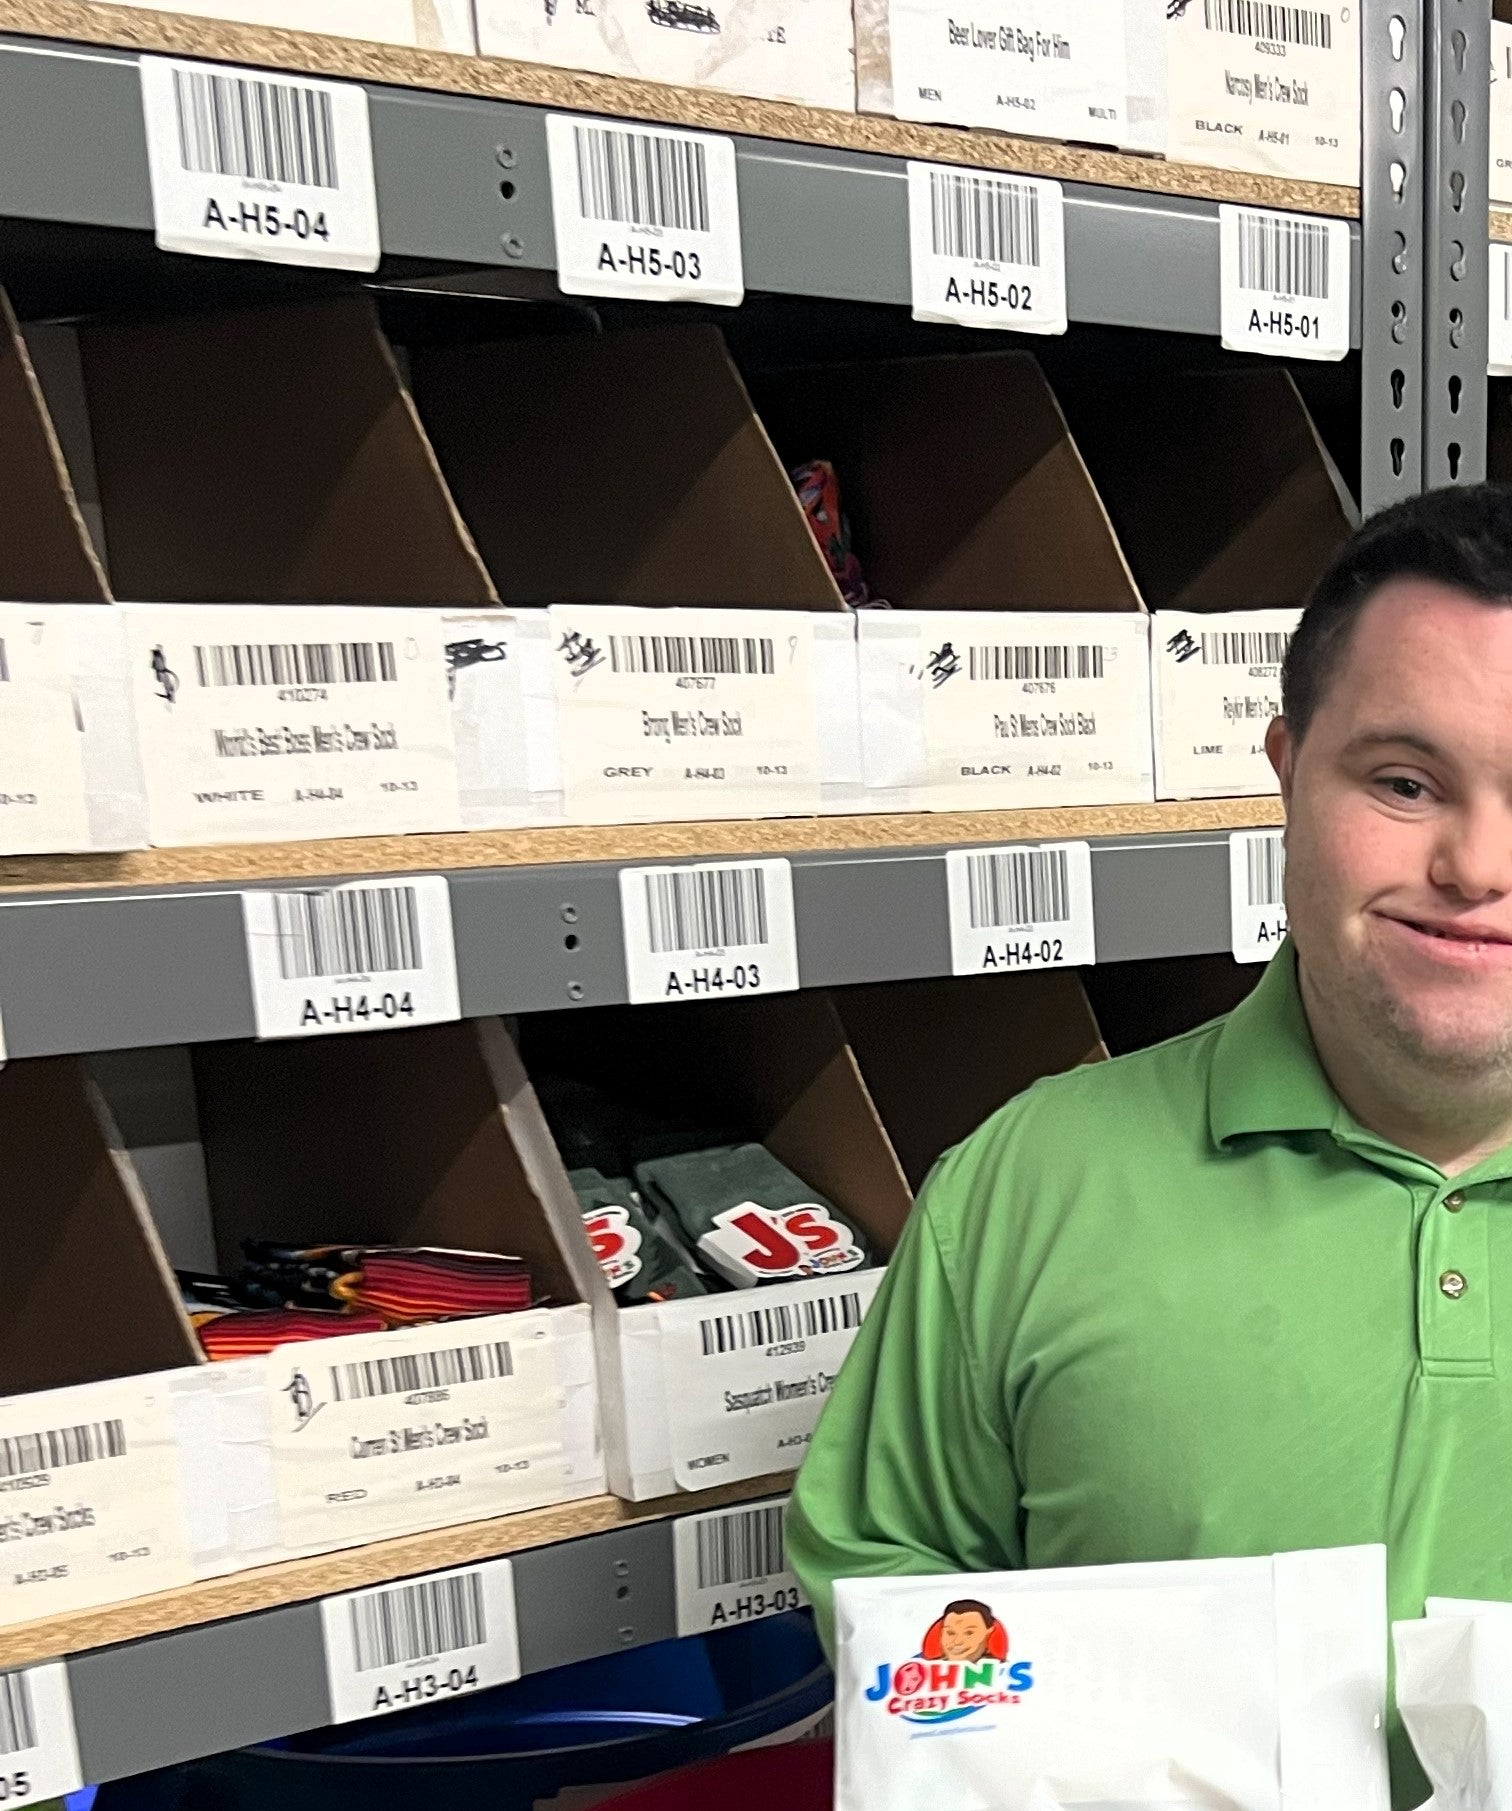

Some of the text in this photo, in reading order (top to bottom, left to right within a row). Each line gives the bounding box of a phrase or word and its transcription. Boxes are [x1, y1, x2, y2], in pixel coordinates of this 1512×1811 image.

[1194, 119, 1243, 136] BLACK
[202, 197, 331, 242] A-H5-04
[598, 242, 702, 282] A-H5-03
[945, 277, 1033, 312] A-H5-02
[1247, 308, 1320, 340] A-H5-01
[1193, 745, 1223, 755] LIME
[603, 766, 654, 779] GREY
[960, 765, 1012, 777] BLACK
[193, 789, 265, 804] WHITE
[982, 939, 1064, 968] A-H4-02
[664, 964, 761, 996] A-H4-03
[299, 991, 415, 1028] A-H4-04
[818, 1372, 840, 1392] Cre
[326, 1489, 368, 1503] RED
[710, 1587, 800, 1626] A-H3-03
[371, 1664, 480, 1712] A-H3-04
[866, 1660, 1034, 1702] JOHN'S
[887, 1690, 1022, 1715] Crazy Socks
